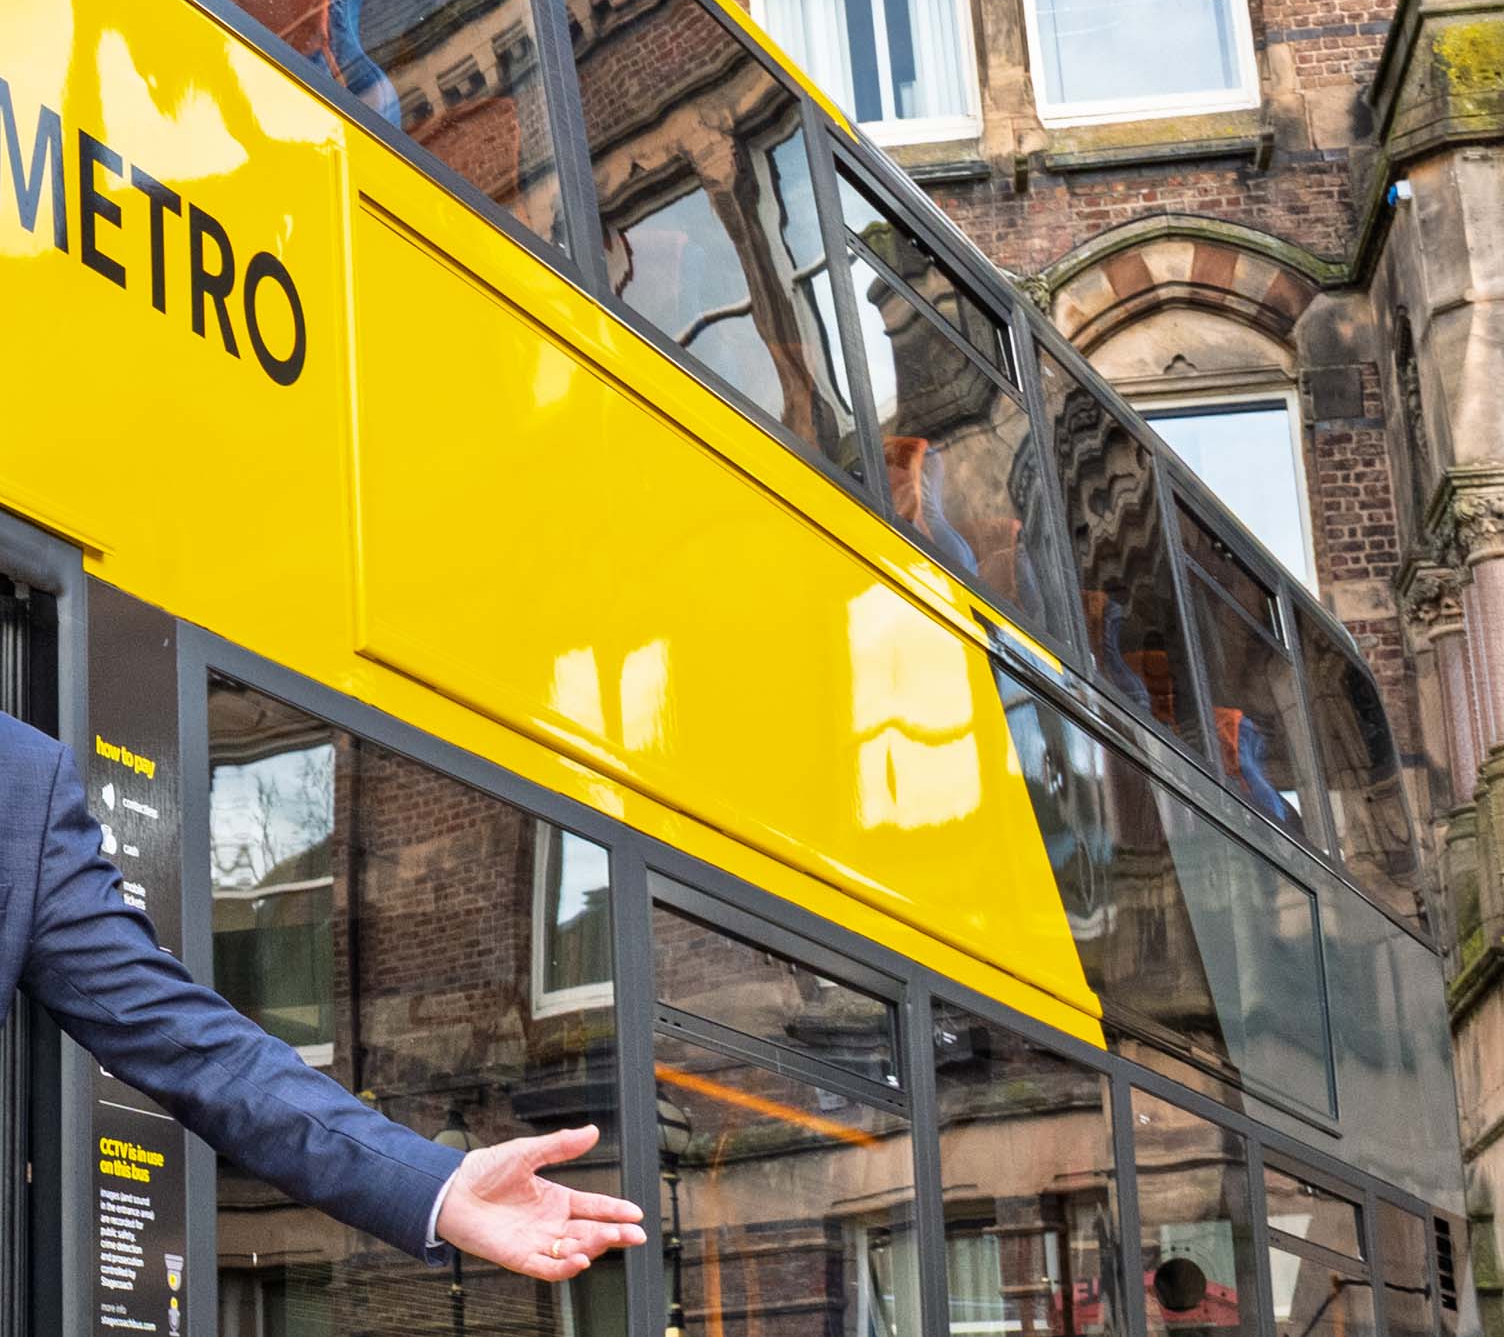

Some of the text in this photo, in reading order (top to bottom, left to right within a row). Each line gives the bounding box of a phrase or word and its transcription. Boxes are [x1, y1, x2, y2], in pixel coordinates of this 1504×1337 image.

[96, 735, 156, 779] how to pay
[100, 1137, 164, 1167] CCTV is in use
[100, 1160, 151, 1182] on this bus
